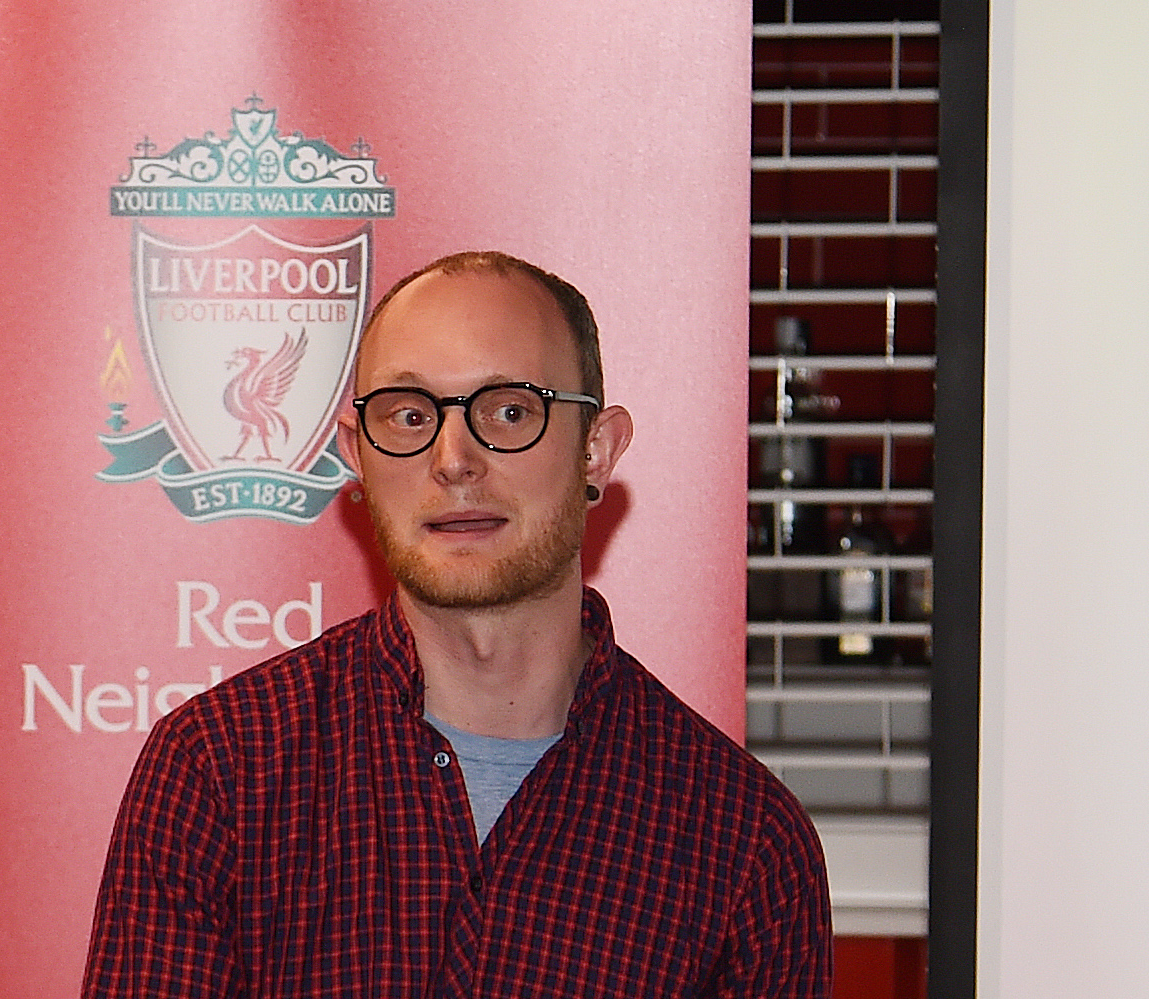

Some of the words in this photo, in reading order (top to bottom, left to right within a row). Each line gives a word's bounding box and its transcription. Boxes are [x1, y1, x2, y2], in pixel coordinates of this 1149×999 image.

[115, 190, 183, 212] YOU'LL
[186, 191, 254, 213] NEVER
[255, 191, 318, 212] WALK
[320, 193, 392, 213] ALONE
[150, 257, 359, 294] LIVERPOOL
[158, 303, 280, 323] FOOTBALL
[286, 303, 349, 323] CLUB
[175, 580, 323, 650] Red
